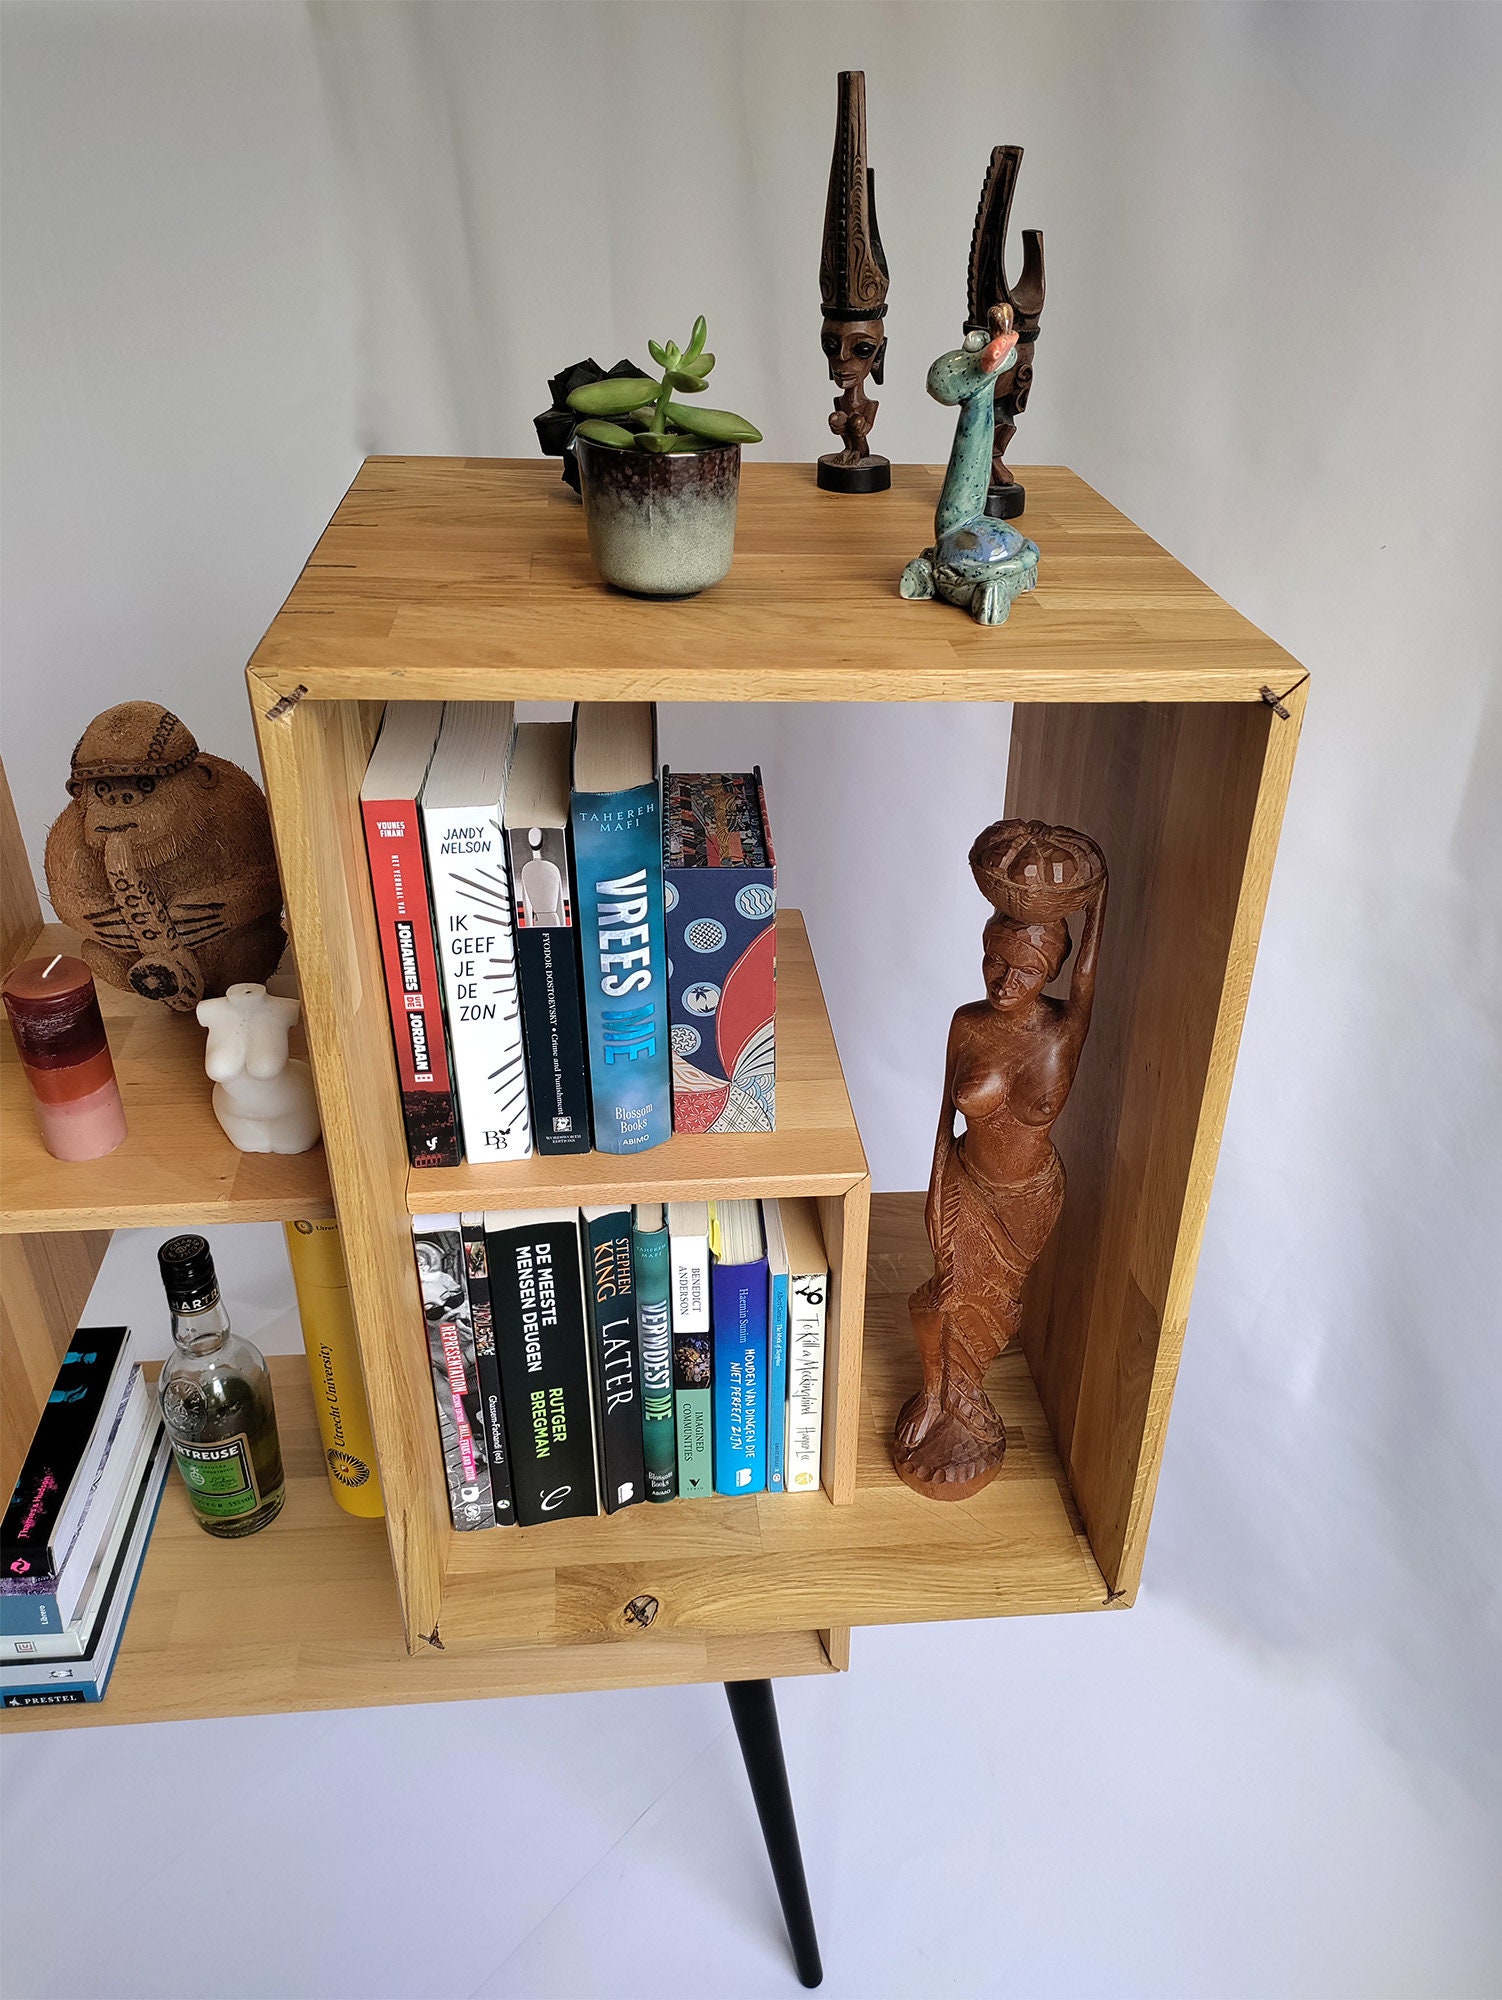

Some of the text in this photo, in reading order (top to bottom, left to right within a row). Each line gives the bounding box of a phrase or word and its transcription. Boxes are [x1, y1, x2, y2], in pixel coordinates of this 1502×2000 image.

[376, 821, 406, 830] YOUNES
[443, 827, 485, 841] JANDY
[580, 803, 655, 823] TAHEREH
[600, 819, 640, 832] MAFI
[440, 840, 491, 855] NELSON
[449, 914, 468, 932] IK
[451, 935, 495, 954] GEEF
[398, 923, 418, 991] JOHANNES
[453, 961, 475, 978] JE
[542, 932, 558, 1026] FYODOR DOSTOEVSKY
[595, 868, 656, 1066] VREES ME
[406, 996, 414, 1008] DE
[457, 983, 478, 1000] DE
[459, 1003, 496, 1021] ZON
[409, 1012, 430, 1072] JORDAAN
[551, 1033, 564, 1115] Crime and Punishment
[615, 1103, 653, 1120] Blossom
[620, 1118, 648, 1134] Books
[622, 1134, 650, 1146] ABIMO
[535, 1243, 558, 1327] DE MEESTE
[594, 1239, 618, 1303] KING
[615, 1237, 631, 1296] STEPHEN
[678, 1266, 689, 1316] ANDERSON
[691, 1268, 702, 1312] BENEDICT
[515, 1245, 543, 1373] MENSEN DEUGEN
[738, 1288, 748, 1343] Haemin Sunim
[440, 1324, 468, 1394] REPRESENTATION
[602, 1317, 634, 1415] LATER
[641, 1300, 672, 1421] VERWOEST ME
[792, 1312, 820, 1415] To Kill a Mockingbird
[320, 1342, 346, 1447] Utrecht University
[549, 1387, 568, 1443] RUTGER
[730, 1362, 743, 1450] NIET PERFECT ZIJN
[742, 1348, 756, 1458] HOUDEN VAN DINGEN DIE
[530, 1390, 551, 1459] BREGMAN
[682, 1403, 694, 1462] COMMUNITIES
[694, 1412, 704, 1452] IMAGINED
[17, 1507, 37, 1539] Thames
[32, 1474, 51, 1502] Hudson
[24, 1694, 78, 1705] PRESTEL
